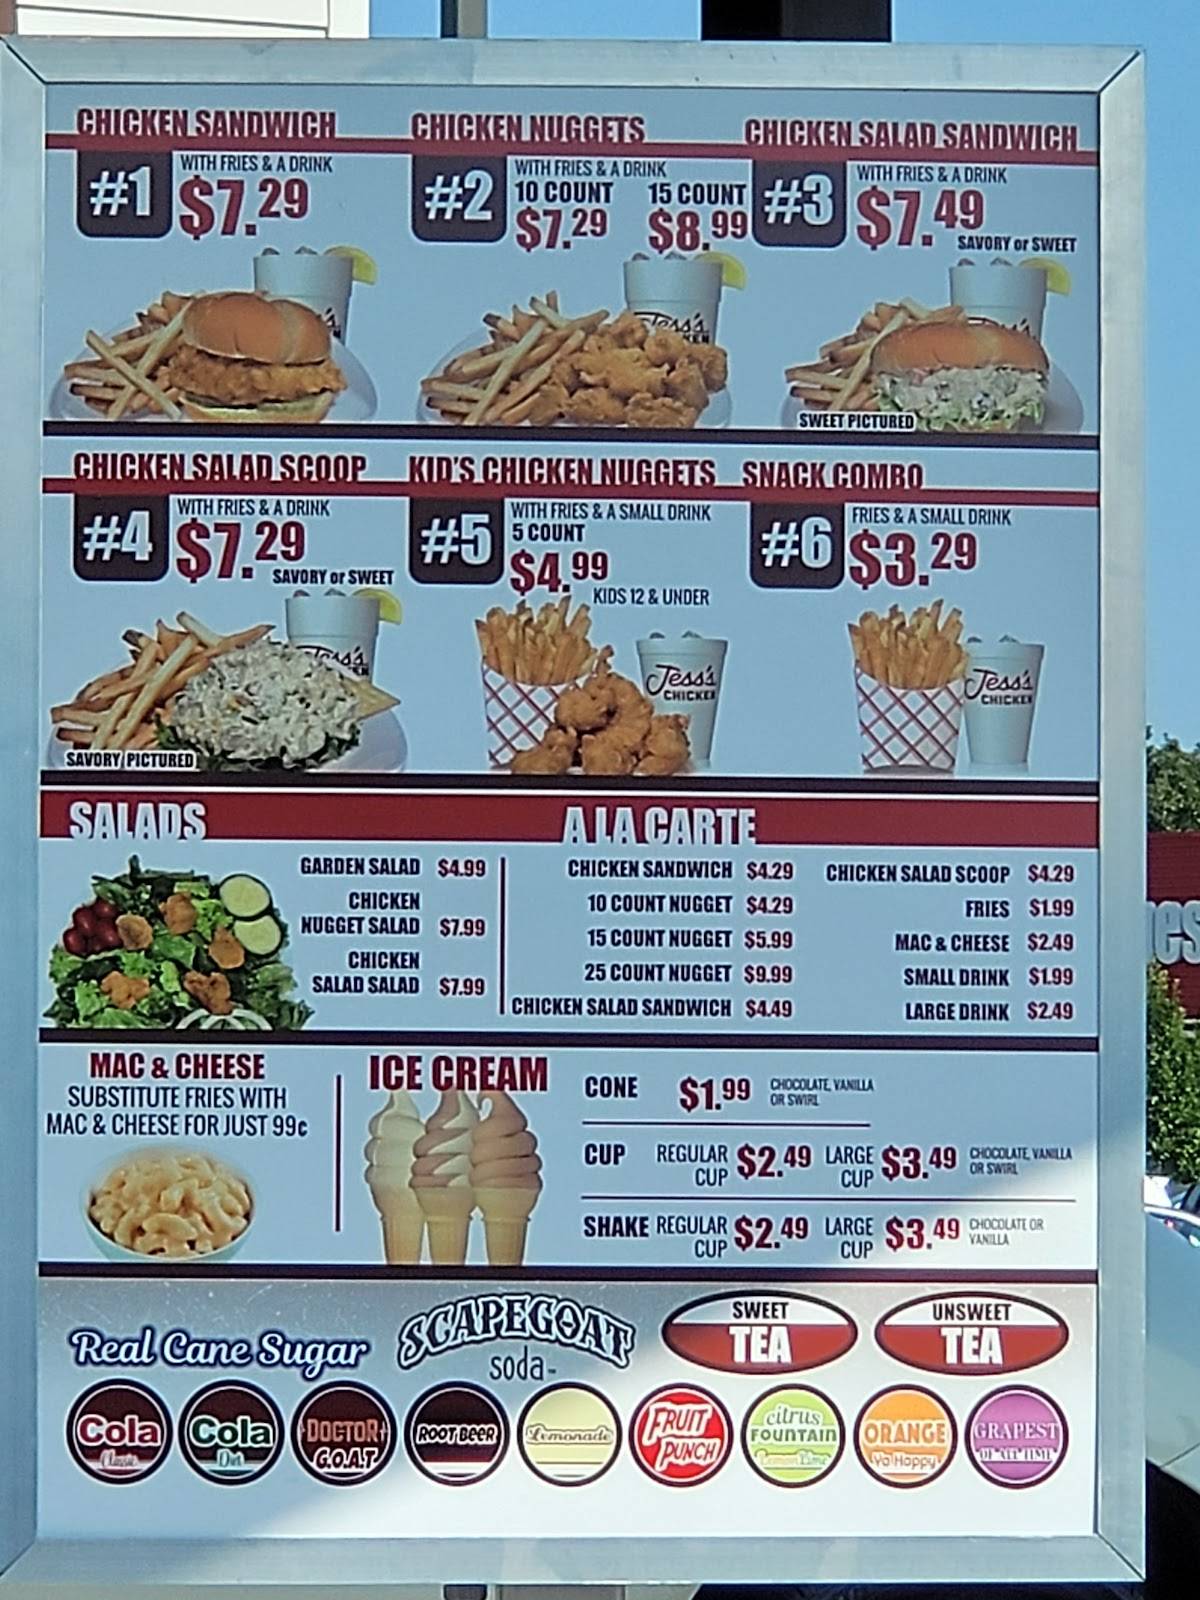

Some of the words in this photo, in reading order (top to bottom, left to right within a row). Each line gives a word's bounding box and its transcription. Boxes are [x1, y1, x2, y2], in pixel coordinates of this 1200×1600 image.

[77, 109, 188, 135] CHICKEN
[195, 110, 336, 138] SANDWICH
[411, 112, 522, 141] CHICKEN
[530, 115, 645, 142] NUGGETS
[745, 119, 851, 146] CHICKEN
[859, 121, 936, 148] SALAD
[943, 124, 1078, 150] SANDWICH
[180, 155, 216, 170] WITH
[220, 155, 257, 171] FRIES
[262, 156, 272, 171] &
[277, 157, 285, 172] A
[289, 156, 333, 172] DRINK
[858, 166, 893, 181] WITH
[896, 166, 934, 182] FRIES
[938, 167, 948, 182] &
[952, 167, 961, 183] A
[965, 167, 1007, 184] DRINK
[90, 165, 150, 216] #1
[425, 169, 493, 220] #2
[515, 181, 539, 203] 10
[545, 182, 614, 204] COUNT
[649, 183, 672, 204] 15
[678, 184, 746, 205] COUNT
[764, 175, 833, 225] #3
[179, 175, 308, 240] $7.29
[857, 185, 984, 250] $7.49
[516, 206, 608, 251] $7.29
[649, 208, 747, 253] $8.99
[958, 235, 1010, 251] SAVORY
[1013, 238, 1029, 251] or
[1033, 237, 1077, 252] SWEET
[799, 413, 845, 429] SWEET
[848, 414, 914, 430] PICTURED
[74, 453, 186, 481] CHICKEN
[192, 454, 273, 481] SALAD
[280, 455, 367, 482] SCOOP
[410, 455, 475, 482] KID'S
[482, 457, 592, 483] CHICKEN
[600, 459, 716, 485] NUGGETS
[743, 461, 825, 487] SNACK
[832, 463, 924, 489] COMBO
[511, 503, 547, 519] WITH
[551, 503, 589, 520] FRIES
[592, 503, 602, 520] &
[606, 504, 615, 520] A
[619, 504, 664, 521] SMALL
[668, 505, 712, 522] DRINK
[83, 511, 153, 561] #4
[420, 513, 493, 565] #5
[512, 524, 523, 542] 5
[526, 524, 584, 543] COUNT
[761, 516, 834, 569] #6
[176, 519, 306, 584] $7.29
[850, 530, 977, 589] $3.29
[510, 549, 609, 596] $4.99
[593, 588, 626, 604] KIDS
[629, 588, 644, 605] 12
[647, 588, 658, 605] &
[661, 589, 710, 606] UNDER
[646, 664, 717, 693] Jess's
[964, 668, 1033, 698] Jess's
[66, 752, 120, 768] SAVORY
[127, 753, 194, 768] PICTURED
[69, 802, 206, 839] SALADS
[563, 807, 590, 844] A
[595, 807, 636, 845] LA
[643, 808, 757, 845] CARTE
[300, 857, 365, 876] GARDEN
[368, 858, 420, 877] SALAD
[438, 859, 486, 878] $4.99
[568, 860, 639, 878] CHICKEN
[643, 861, 733, 879] SANDWICH
[747, 862, 793, 880] $4.29
[826, 864, 898, 882] CHICKEN
[901, 865, 952, 883] SALAD
[956, 865, 1010, 884] SCOOP
[1028, 864, 1075, 883] $4.29
[349, 893, 420, 910] CHICKEN
[965, 900, 1010, 918] FRIES
[1029, 899, 1074, 918] $1.99
[301, 917, 364, 935] NUGGET
[368, 918, 419, 935] SALAD
[440, 919, 485, 938] $7.99
[1028, 934, 1074, 953] $2.49
[348, 952, 420, 969] CHICKEN
[904, 968, 956, 986] SMALL
[958, 968, 1010, 987] DRINK
[746, 999, 793, 1018] $4.49
[905, 1002, 955, 1021] LARGE
[958, 1003, 1010, 1021] DRINK
[1027, 1002, 1074, 1021] $2.49
[89, 1054, 146, 1078] MAC
[152, 1057, 168, 1078] &
[174, 1055, 265, 1079] CHEESE
[369, 1057, 423, 1089] ICE
[431, 1057, 548, 1090] CREAM
[584, 1077, 639, 1098] CONE
[679, 1077, 751, 1111] $1.99
[834, 1078, 874, 1092] VANILLA
[68, 1087, 180, 1107] SUBSTITUTE
[185, 1087, 233, 1108] FRIES
[239, 1088, 287, 1109] WITH
[46, 1114, 89, 1135] MAC
[93, 1115, 107, 1134] &
[111, 1115, 180, 1135] CHEESE
[183, 1116, 218, 1136] FOR
[222, 1116, 267, 1136] JUST
[584, 1144, 626, 1166] CUP
[657, 1144, 728, 1164] REGULAR
[736, 1144, 811, 1180] $2.49
[825, 1146, 874, 1165] LARGE
[882, 1146, 957, 1182] $3.49
[695, 1168, 728, 1186] CUP
[841, 1169, 874, 1188] CUP
[584, 1216, 649, 1238] SHAKE
[733, 1215, 808, 1251] $2.49
[885, 1216, 960, 1253] $3.49
[970, 1218, 1027, 1230] CHOCOLATE
[1030, 1219, 1045, 1230] OR
[970, 1233, 1009, 1246] VANILLA
[733, 1303, 789, 1320] SWEET
[932, 1303, 1011, 1322] UNSWEET
[399, 1293, 636, 1369] SCAPEGOAT
[69, 1330, 155, 1366] Real
[163, 1333, 251, 1368] Cane
[258, 1333, 368, 1380] Sugar
[729, 1326, 792, 1363] TEA
[942, 1327, 1003, 1365] TEA
[643, 1403, 712, 1445] FRUIT
[766, 1406, 821, 1426] citrus
[78, 1415, 161, 1446] Cola
[190, 1416, 273, 1446] Cola
[418, 1425, 458, 1443] ROOT
[864, 1422, 946, 1443] ORANGE
[974, 1423, 1060, 1439] GRAPEST
[656, 1438, 720, 1471] PUNCH
[894, 1454, 936, 1470] Happy
